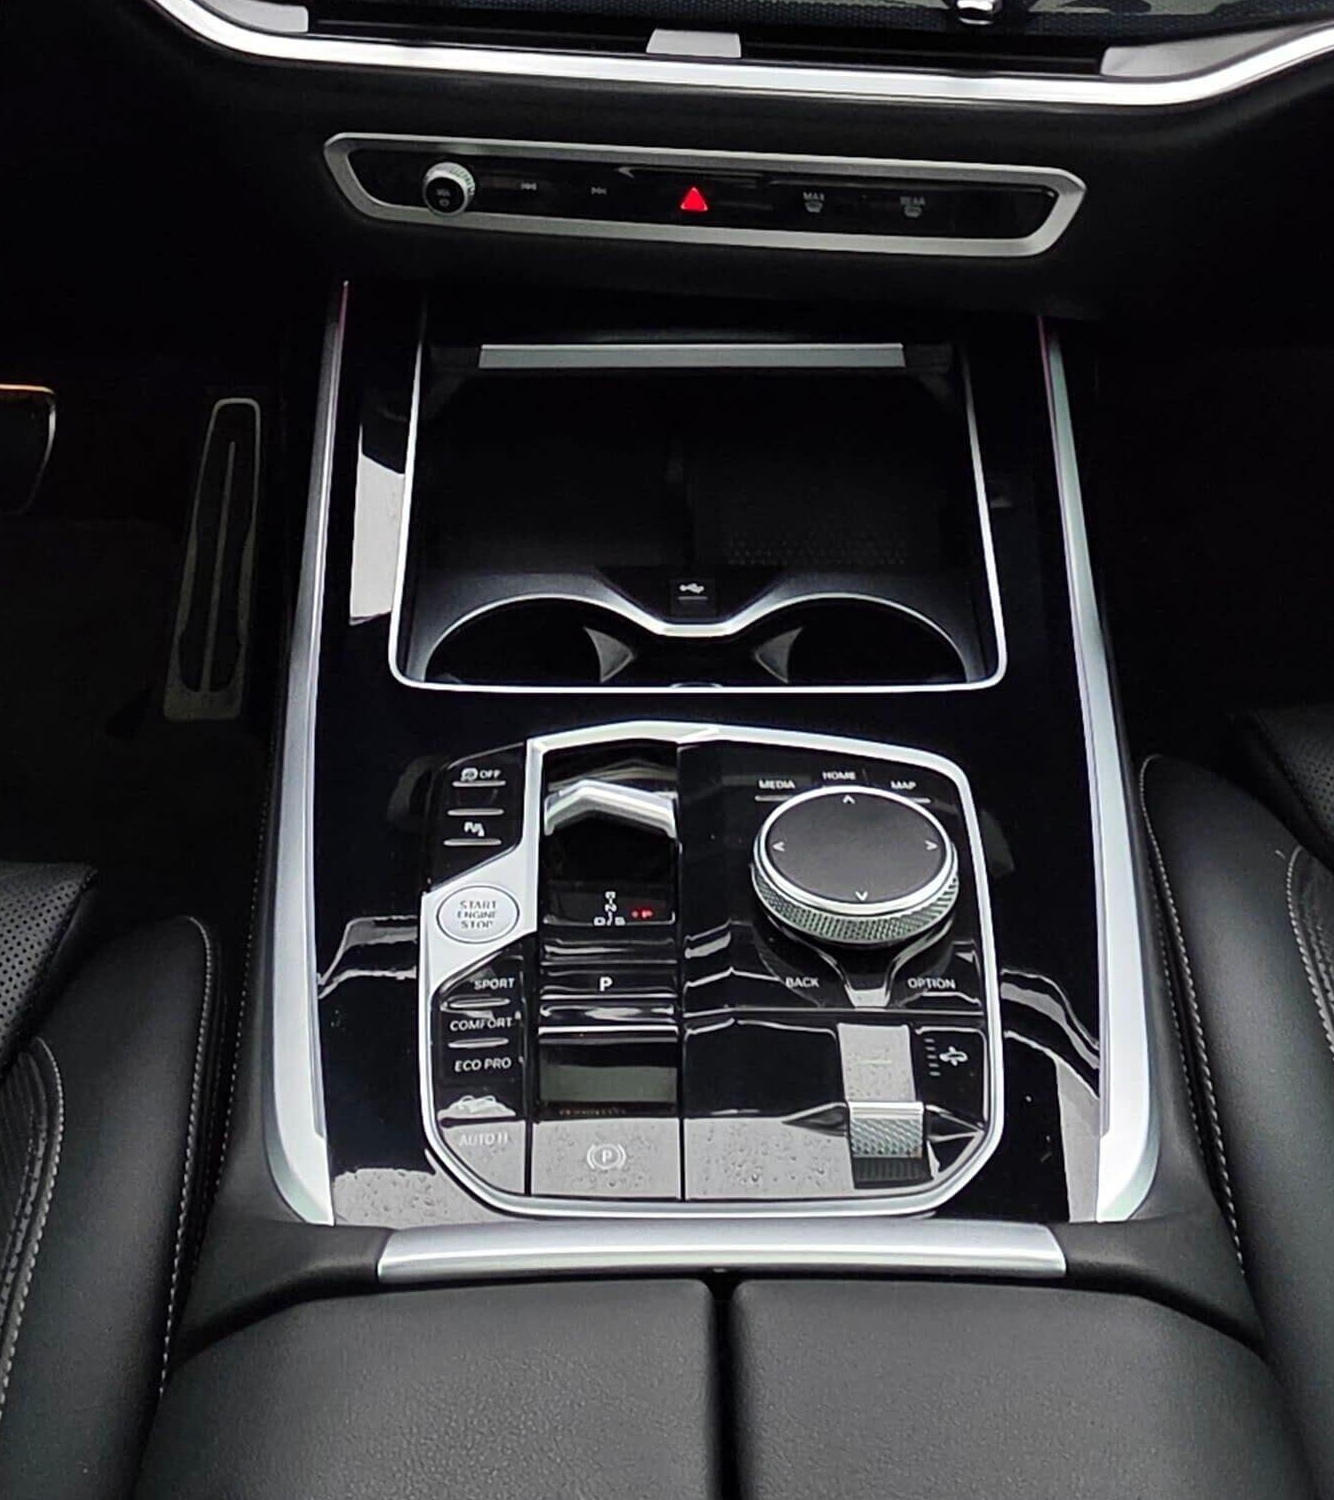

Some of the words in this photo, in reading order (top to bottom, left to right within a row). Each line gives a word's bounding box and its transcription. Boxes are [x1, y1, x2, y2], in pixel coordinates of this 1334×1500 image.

[479, 768, 502, 780] OFF
[822, 770, 857, 781] HOME
[758, 779, 796, 790] MEDIA
[890, 780, 917, 791] MAP
[459, 900, 498, 910] START
[474, 977, 516, 990] SPORT
[598, 976, 613, 992] P
[785, 975, 820, 988] BACK
[907, 977, 956, 990] OPTION
[449, 1017, 513, 1032] COMFORT
[454, 1058, 482, 1072] ECO
[483, 1056, 512, 1070] PRO
[458, 1133, 496, 1147] AUTO
